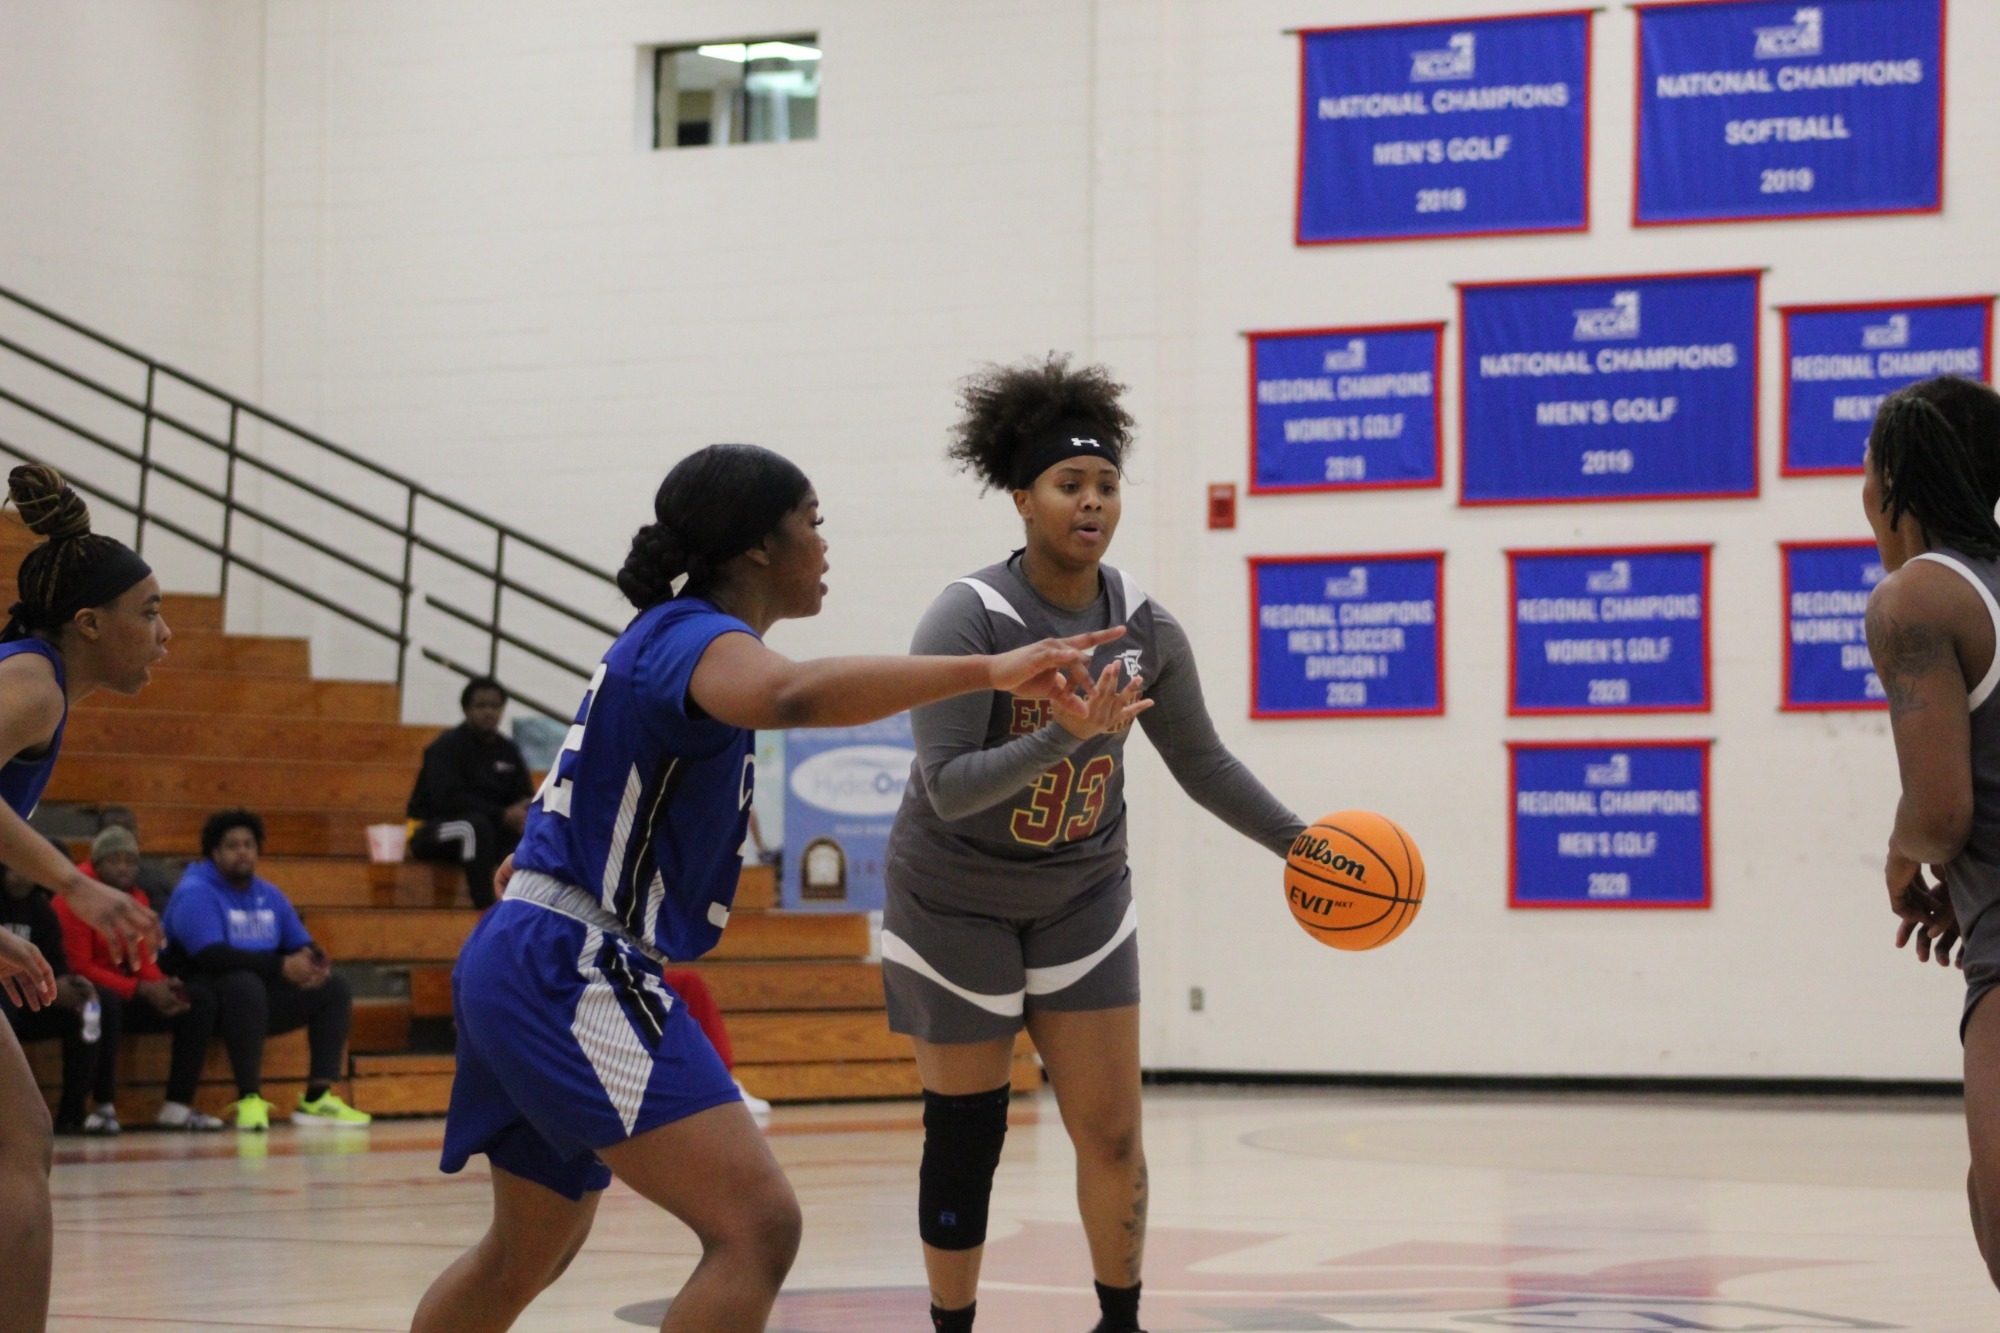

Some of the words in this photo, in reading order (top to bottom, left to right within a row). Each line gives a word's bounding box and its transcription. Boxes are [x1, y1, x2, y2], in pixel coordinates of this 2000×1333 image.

[1656, 69, 1774, 98] NATIONAL
[1777, 59, 1922, 91] CHAMPIONS
[1318, 93, 1429, 119] NATIONAL
[1432, 82, 1569, 113] CHAMPIONS
[1725, 115, 1849, 145] SOFTBALL
[1373, 139, 1446, 165] MEN'S
[1446, 135, 1511, 162] GOLF
[1480, 352, 1593, 377] NATIONAL
[1597, 343, 1737, 373] CHAMPIONS
[1792, 355, 1875, 381] REGIONAL
[1877, 348, 1980, 378] CHAMPIONS
[1258, 378, 1335, 404] REGIONAL
[1337, 371, 1432, 400] CHAMPIONS
[1537, 400, 1611, 425] MEN'S
[1612, 397, 1676, 423] GOLF
[1284, 416, 1361, 442] WOMEN'S
[1361, 414, 1404, 439] GOLF
[1261, 604, 1337, 629] REGIONAL
[1339, 600, 1434, 627] CHAMPIONS
[1518, 598, 1598, 623] REGIONAL
[1601, 594, 1699, 621] CHAMPIONS
[1288, 630, 1340, 654] MEN'S
[1340, 628, 1404, 653] SOCCER
[1545, 639, 1625, 664] WOMEN'S
[1625, 637, 1670, 662] GOLF
[1306, 655, 1377, 679] DIVISION
[1010, 754, 1114, 846] 33
[1518, 791, 1597, 815] REGIONAL
[1600, 790, 1699, 815] CHAMPIONS
[1291, 834, 1365, 881] Wilson
[1559, 832, 1611, 856] MEN'S
[1611, 832, 1656, 856] GOLF
